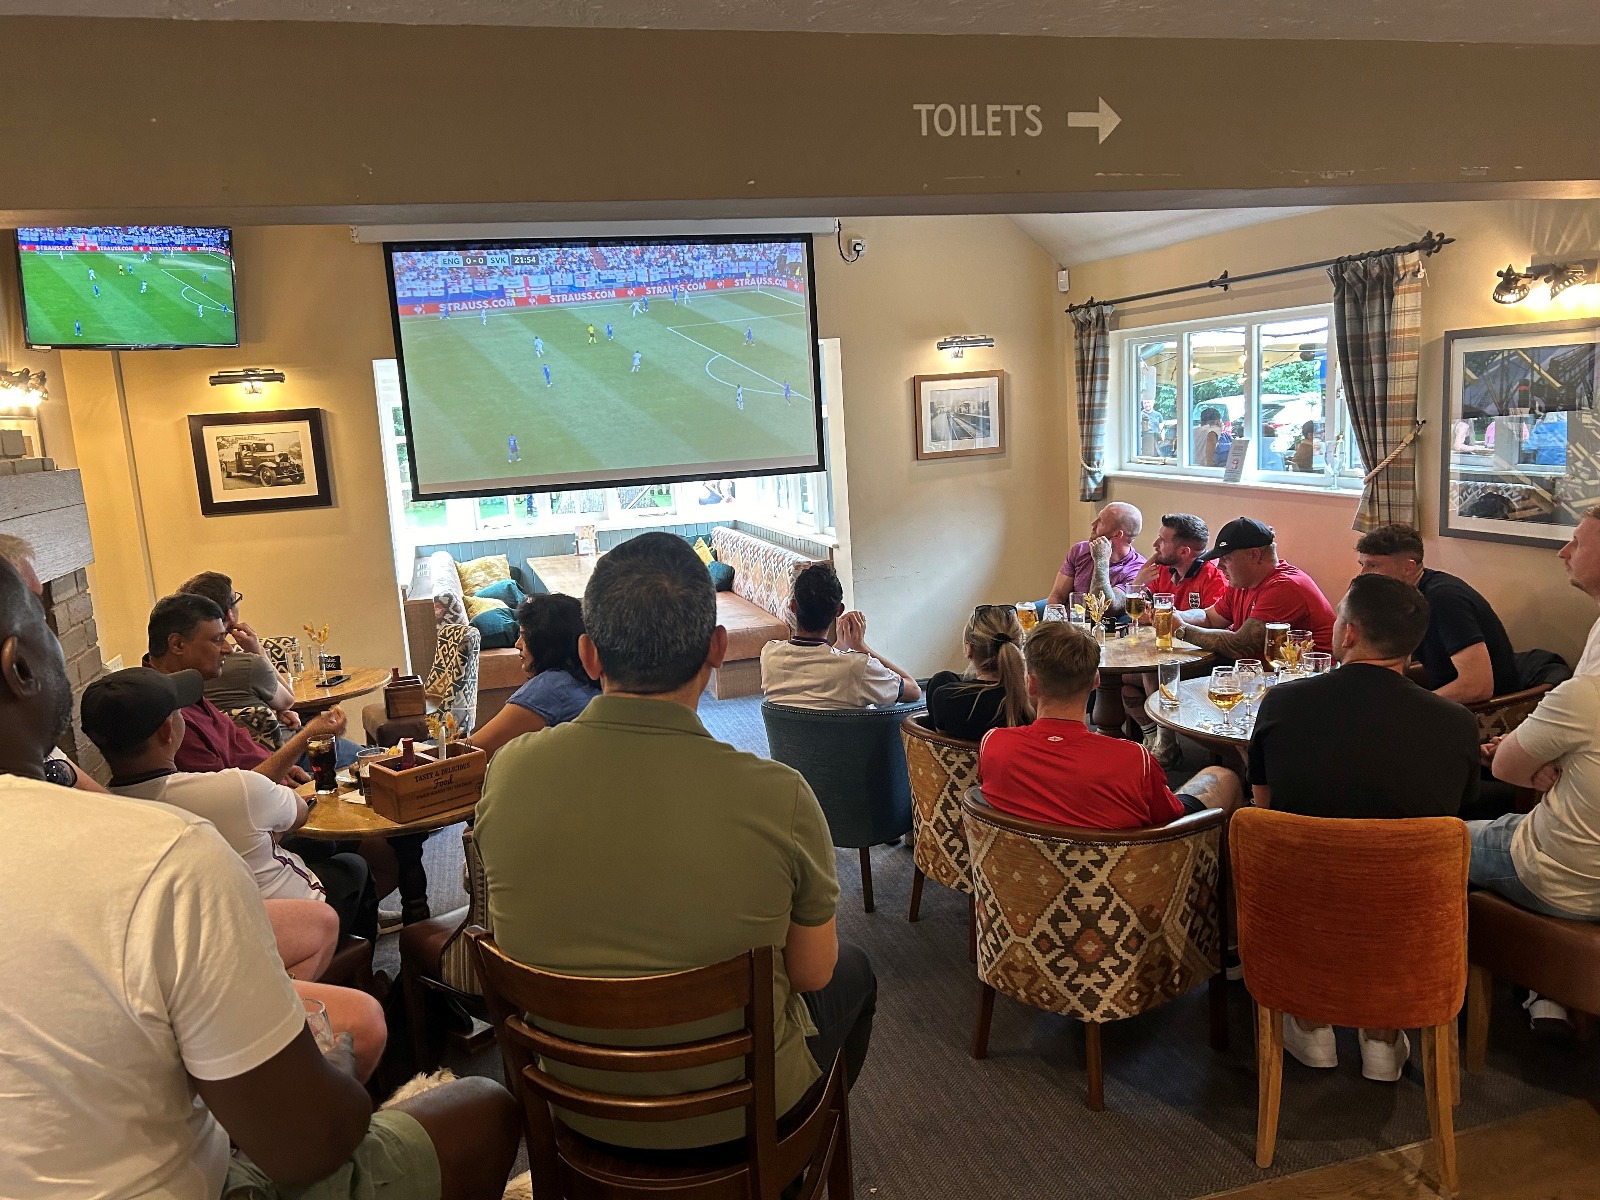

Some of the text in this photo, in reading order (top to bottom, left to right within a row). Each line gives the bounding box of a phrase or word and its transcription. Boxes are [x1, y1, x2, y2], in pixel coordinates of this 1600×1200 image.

[913, 103, 1043, 137] TOILETS
[514, 256, 536, 264] 21:54
[645, 282, 706, 296] STRAUSS.COM
[734, 277, 788, 289] STRAUSS.COM
[549, 289, 616, 303] STRAUSS.COM
[438, 297, 516, 313] STRAUSS.COM
[415, 772, 433, 782] TASTY
[441, 762, 471, 775] DELICIOUS
[433, 775, 454, 789] Food
